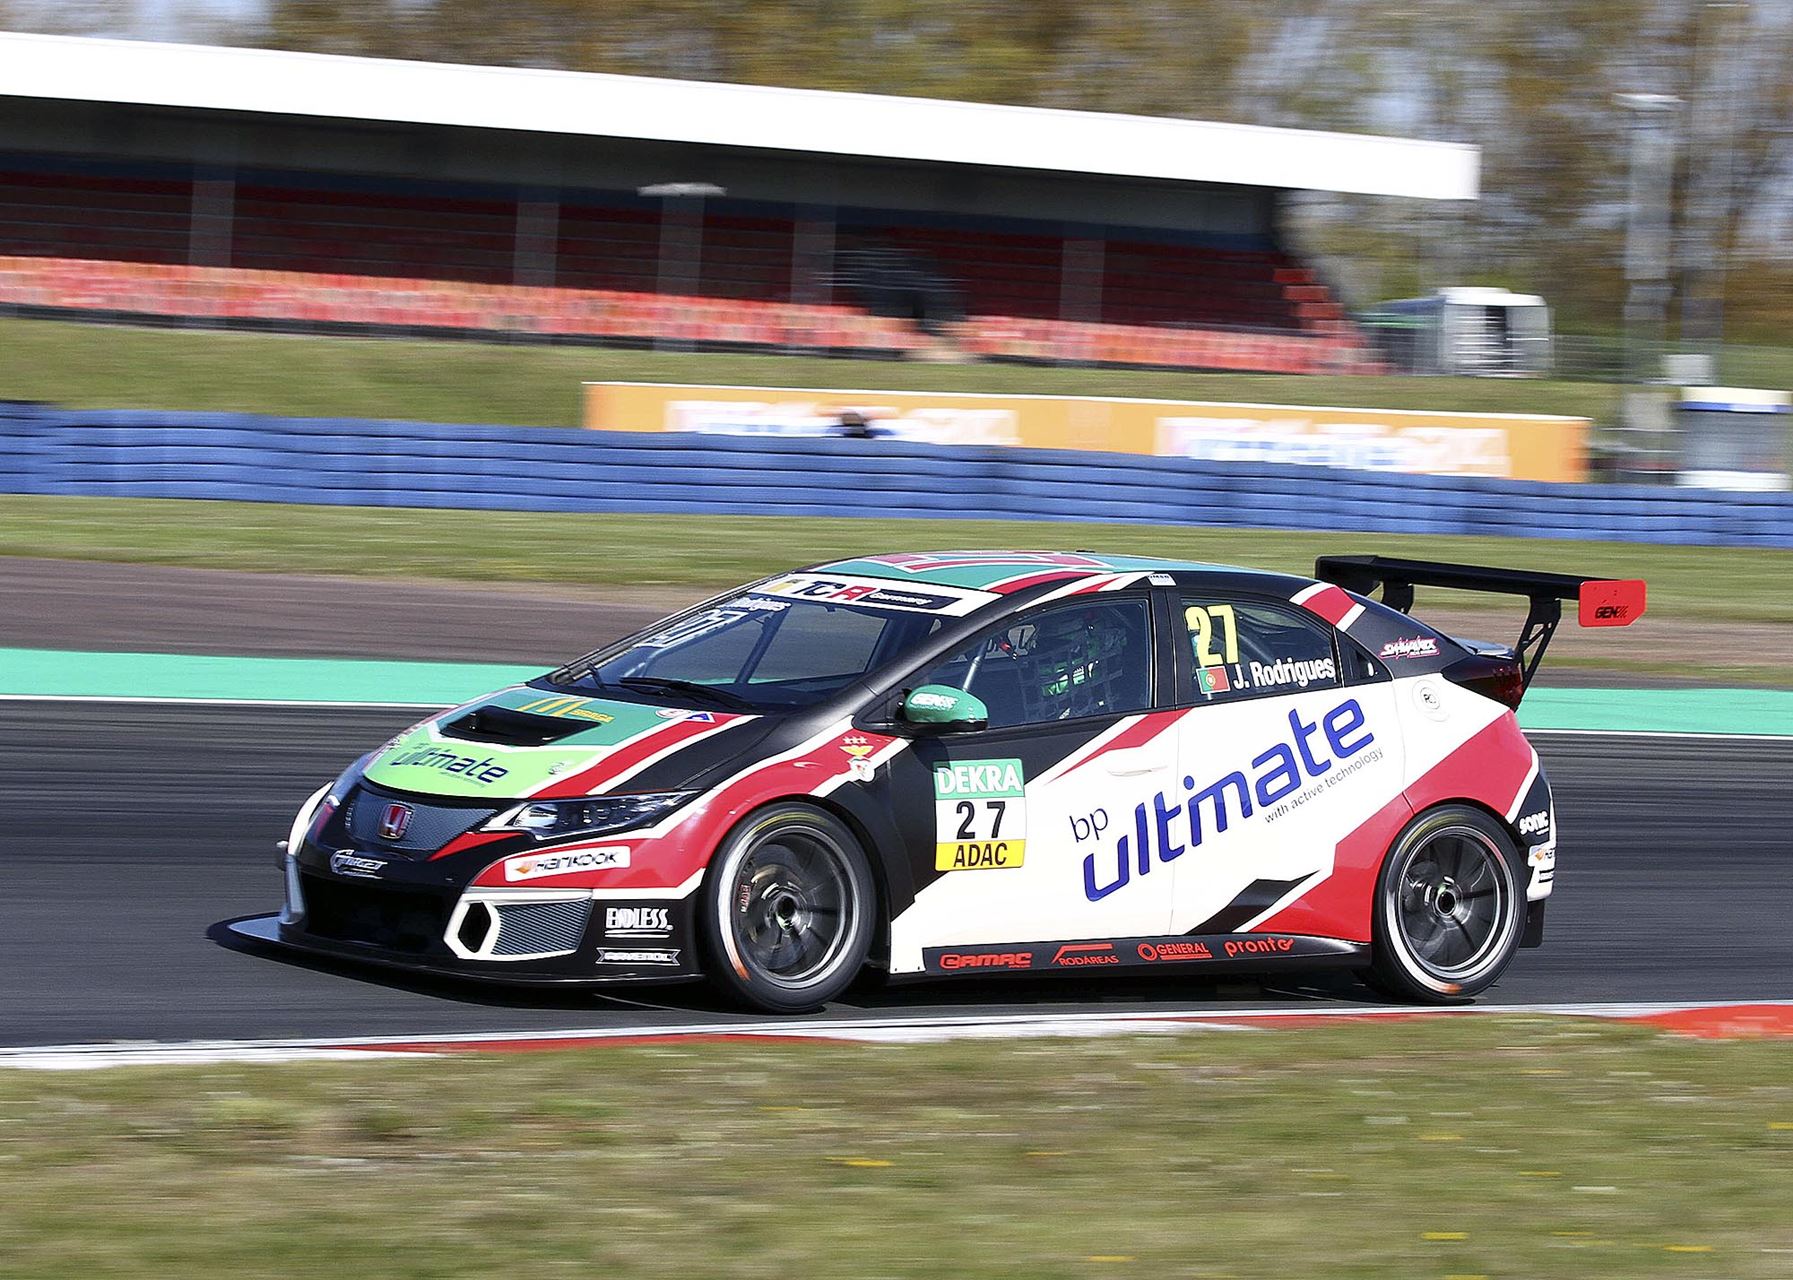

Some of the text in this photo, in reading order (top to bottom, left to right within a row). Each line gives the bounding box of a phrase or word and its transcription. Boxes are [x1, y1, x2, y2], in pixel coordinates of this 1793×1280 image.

[1184, 604, 1239, 667] 27
[1233, 657, 1336, 690] J. Rodrigues
[937, 764, 1022, 795] DEKRA
[1264, 747, 1384, 823] with active technology
[1083, 699, 1374, 902] ultimate
[956, 800, 1006, 840] 27
[1069, 807, 1109, 843] bp
[953, 842, 1008, 867] ADAC
[605, 907, 669, 929] ENDLESS
[1156, 942, 1210, 955] GENERAL
[1224, 937, 1294, 958] pronto
